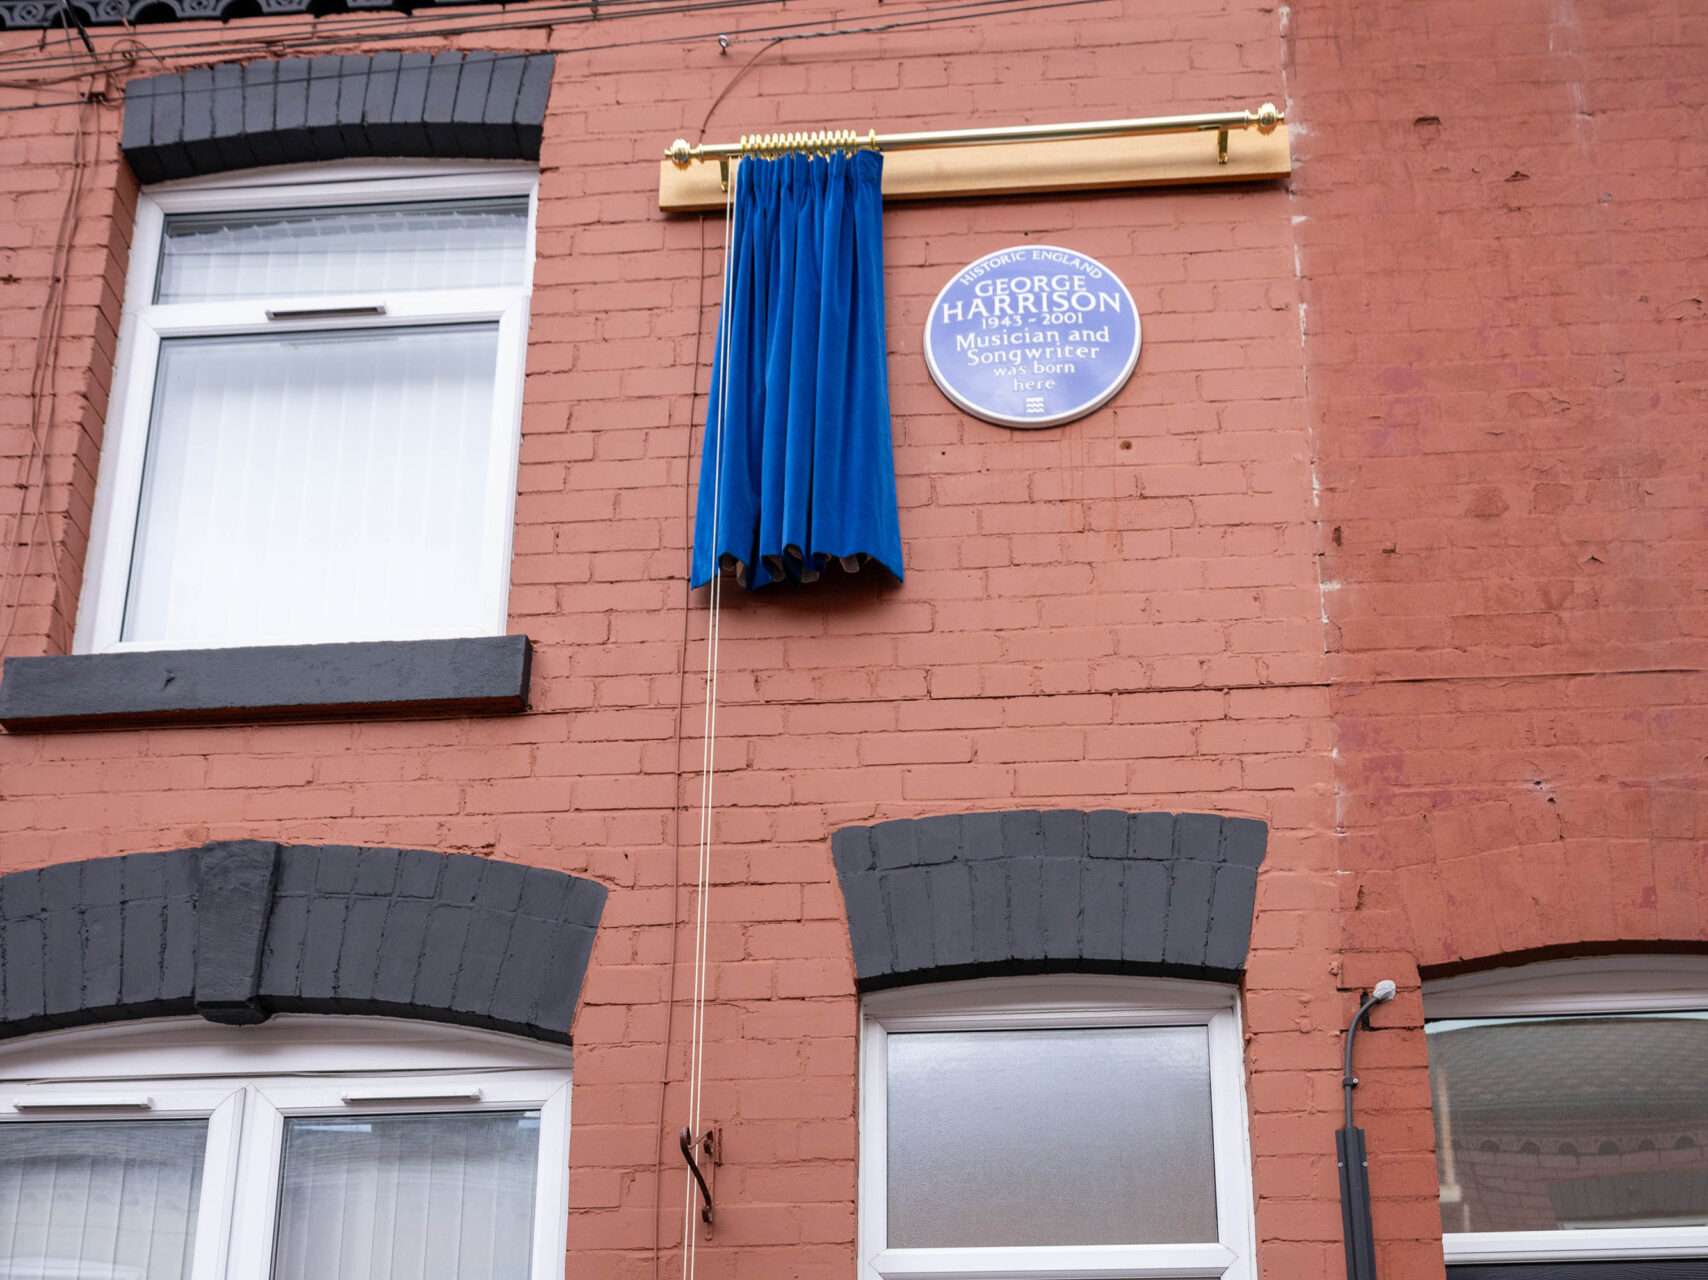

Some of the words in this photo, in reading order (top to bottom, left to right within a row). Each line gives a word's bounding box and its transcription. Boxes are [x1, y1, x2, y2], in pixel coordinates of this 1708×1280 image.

[960, 251, 1026, 286] HISTORIC
[1032, 250, 1103, 279] ENGLAND
[974, 275, 1087, 297] GEORGE
[942, 291, 1121, 324] HARRISON
[982, 315, 1023, 330] 1943
[1041, 311, 1083, 325] 2001
[955, 327, 1060, 352] Musician
[1068, 325, 1110, 343] and
[967, 342, 1100, 366] Songwriter
[993, 365, 1027, 377] was
[1033, 360, 1075, 374] born
[1013, 377, 1056, 391] here
